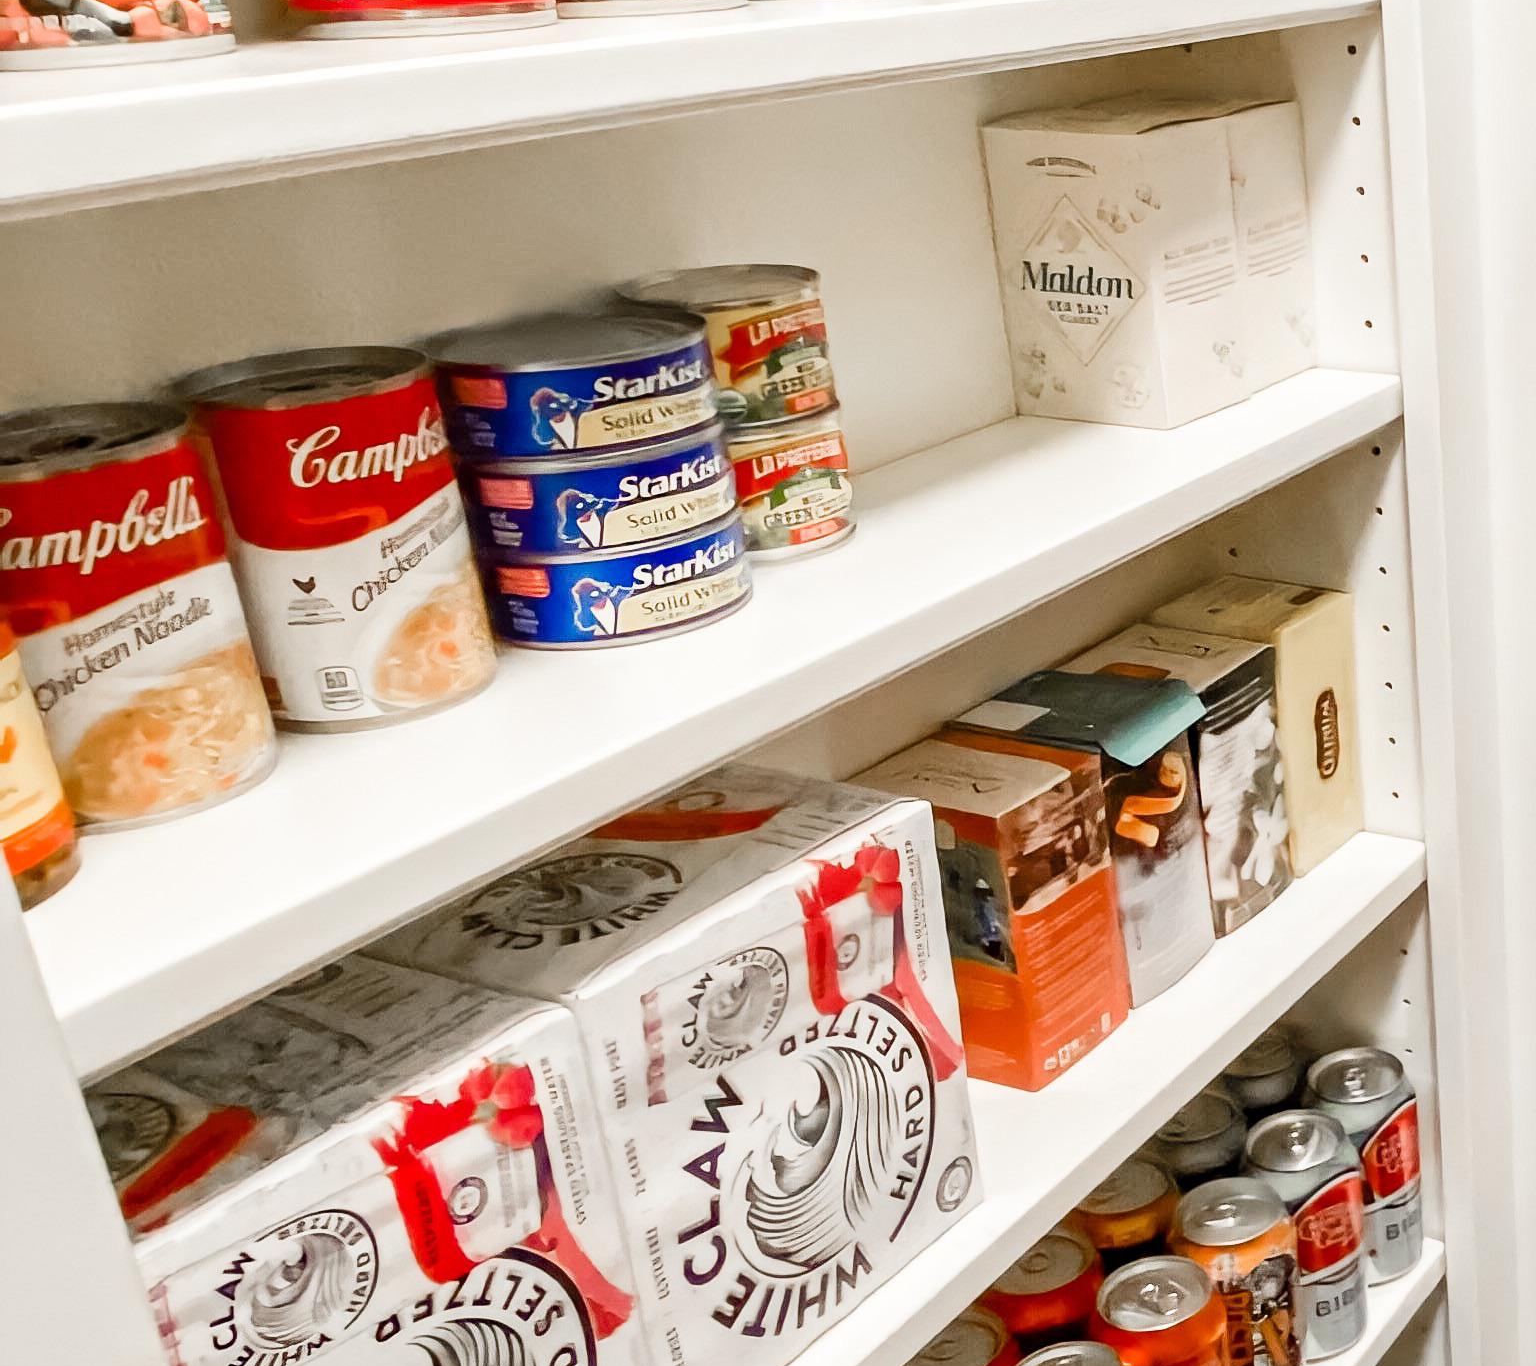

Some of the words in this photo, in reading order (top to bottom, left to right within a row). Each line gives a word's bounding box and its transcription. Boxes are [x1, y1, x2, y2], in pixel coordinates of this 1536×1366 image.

[1020, 259, 1135, 300] Maldon
[593, 359, 703, 403] StarKist
[618, 454, 721, 502] StarKist
[632, 540, 737, 590] StarKist
[681, 972, 713, 1047] CLAW
[677, 1074, 744, 1286] CLAW
[890, 1083, 925, 1202] HARD
[209, 1251, 256, 1350] CLAW
[711, 1242, 873, 1338] WHITE
